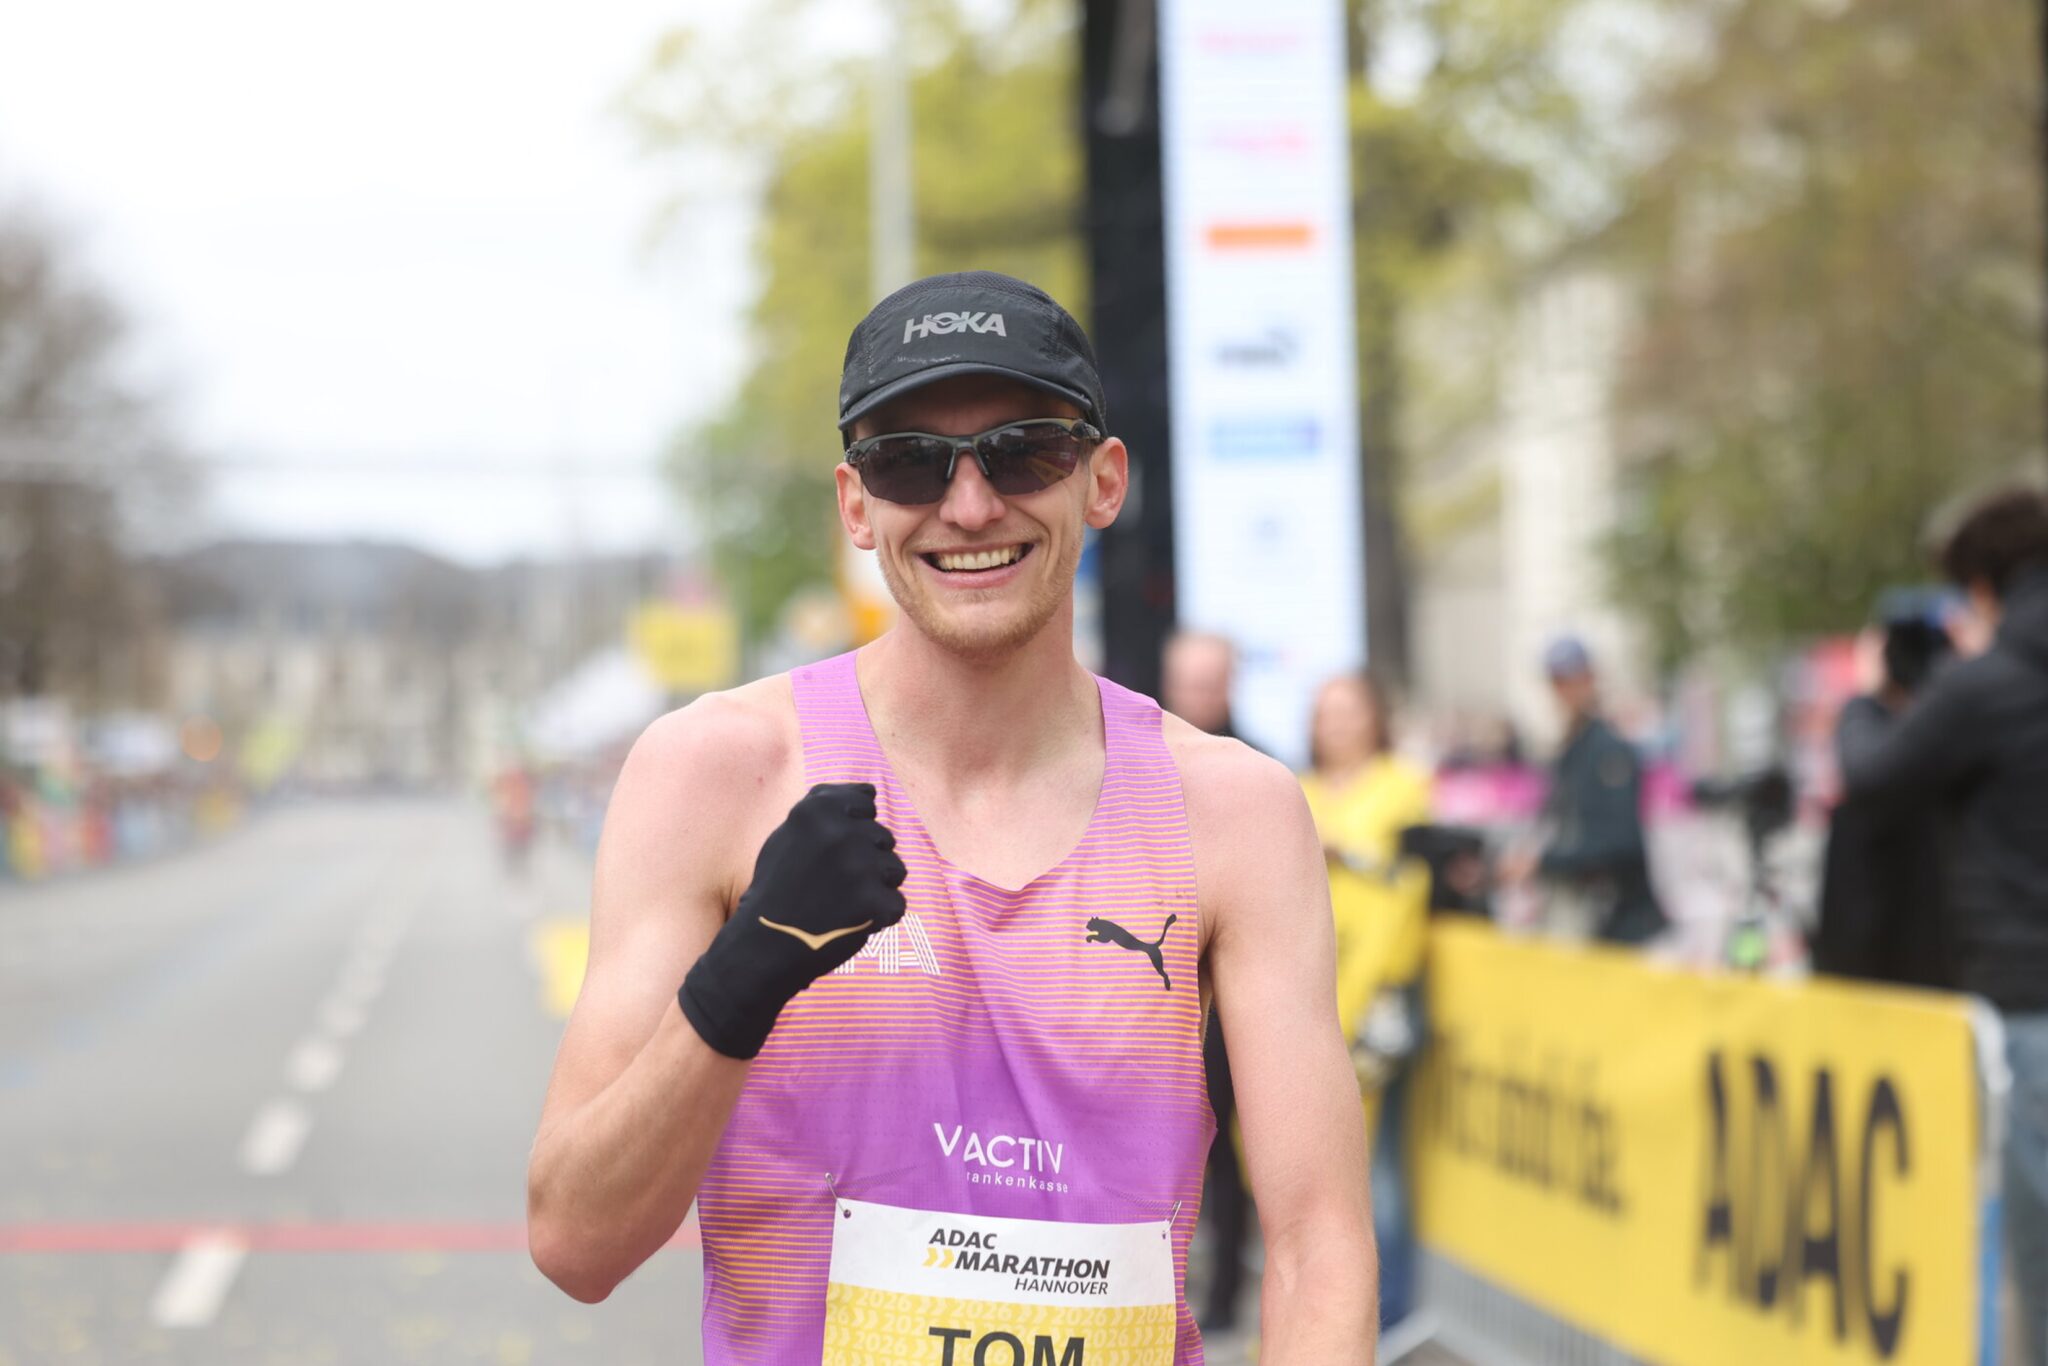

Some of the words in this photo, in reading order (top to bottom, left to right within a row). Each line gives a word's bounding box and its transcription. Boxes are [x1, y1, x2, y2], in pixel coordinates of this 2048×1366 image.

[903, 311, 1007, 344] HOKA
[1694, 1048, 1913, 1363] ADAC
[928, 1228, 998, 1250] ADAC
[954, 1250, 1111, 1279] MARATHON
[1014, 1277, 1109, 1295] HANNOVER
[928, 1326, 1085, 1366] TOM
